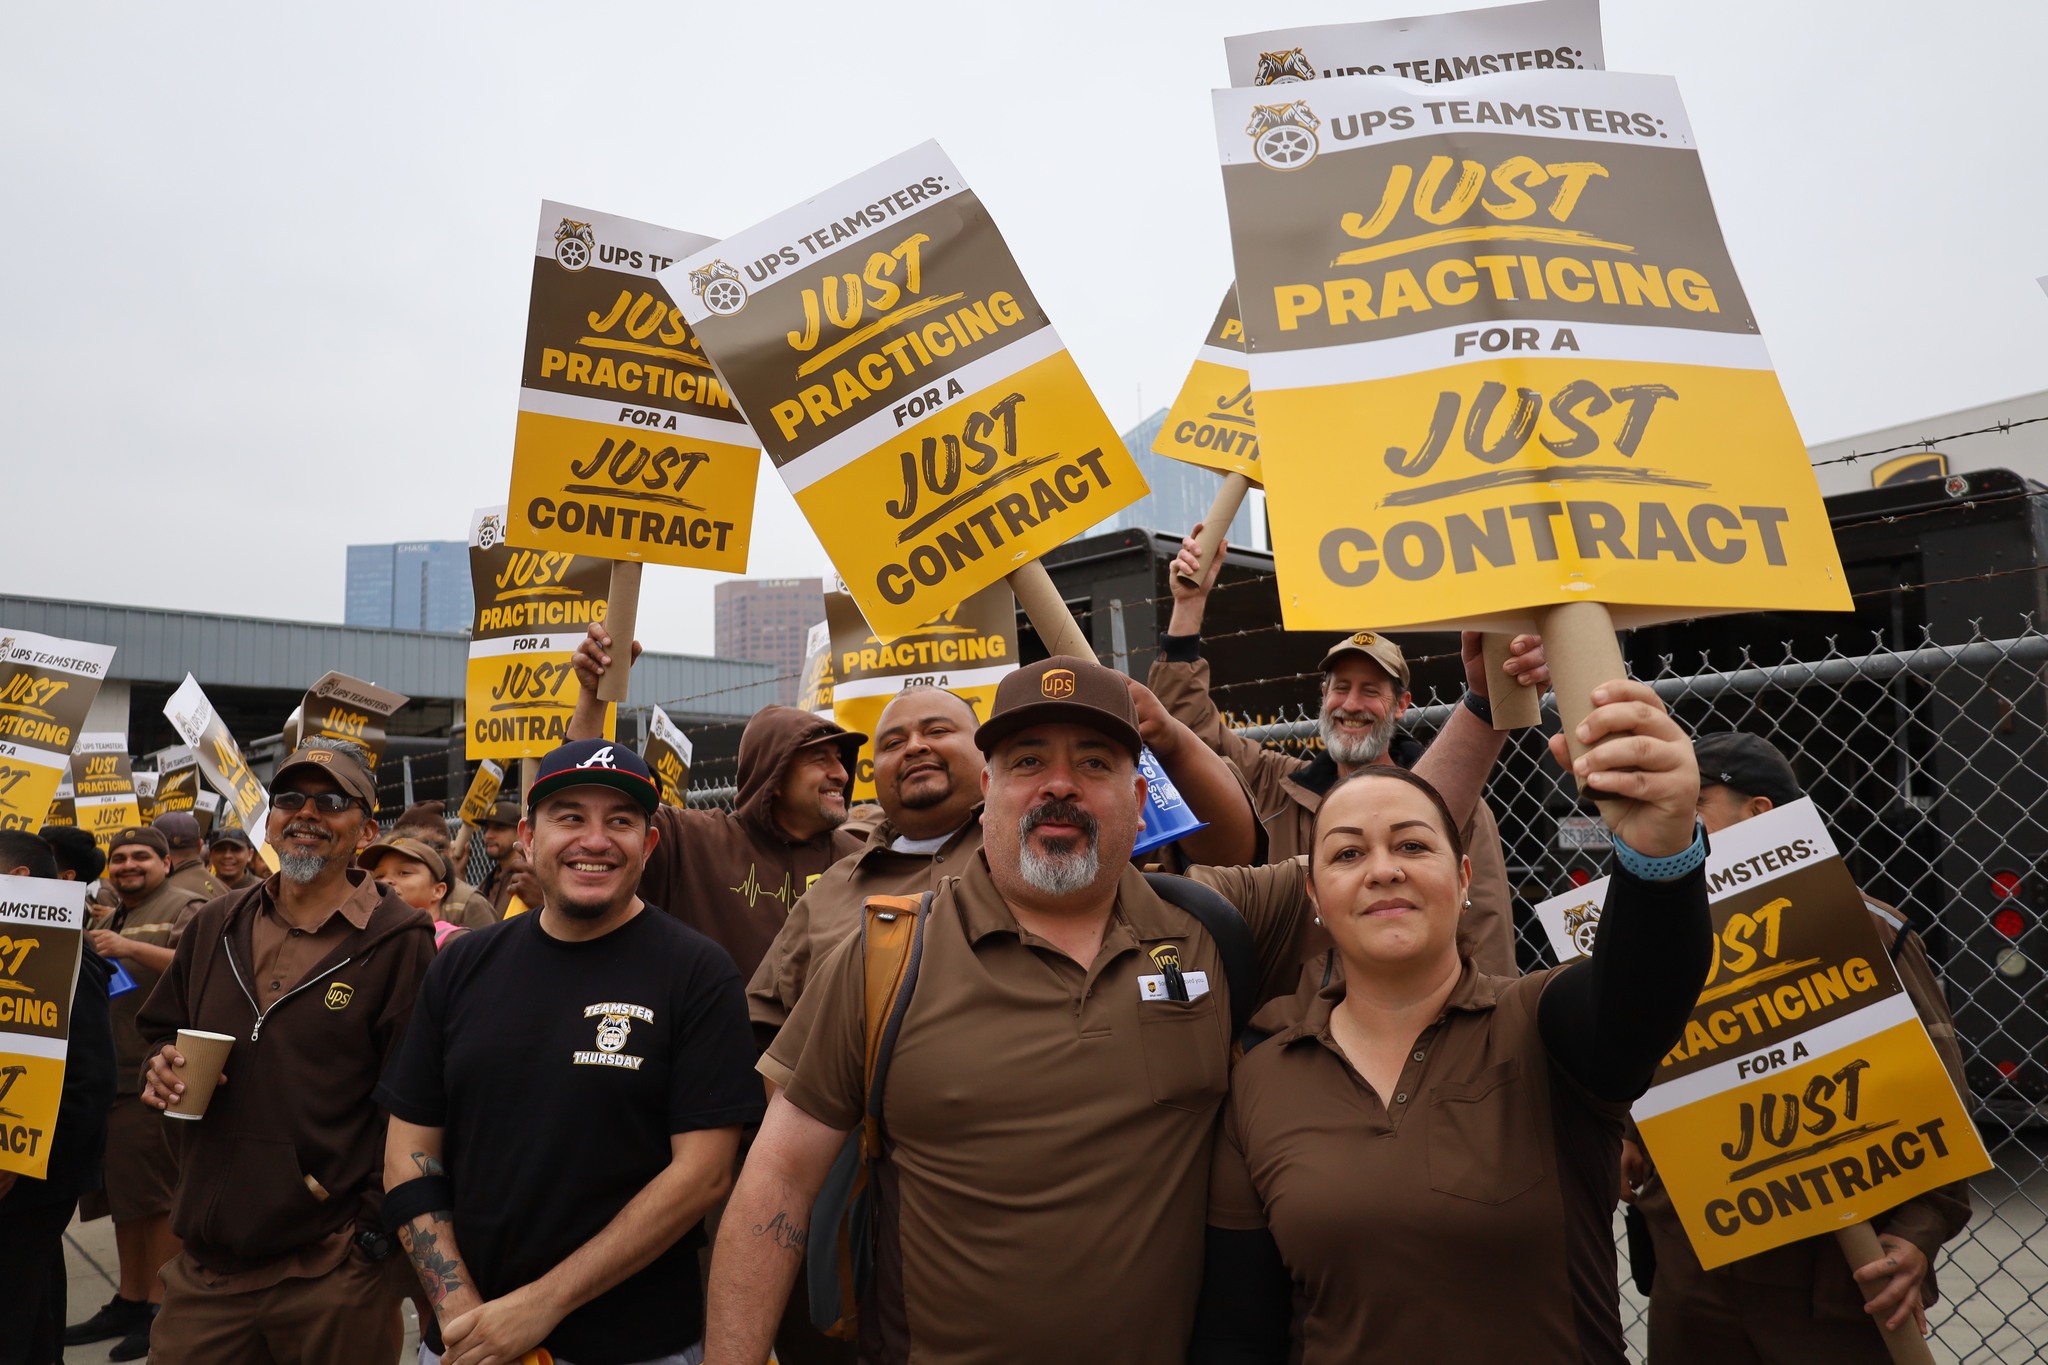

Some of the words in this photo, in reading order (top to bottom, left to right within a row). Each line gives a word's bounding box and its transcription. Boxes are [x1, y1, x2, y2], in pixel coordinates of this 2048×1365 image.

[1331, 105, 1415, 142] UPS
[1423, 101, 1668, 139] TEAMSTERS:
[1340, 154, 1610, 240] JUST
[744, 245, 800, 284] UPS
[798, 175, 950, 256] TEAMSTERS:
[599, 244, 643, 269] UPS
[786, 232, 931, 352] JUST
[1273, 255, 1720, 331] PRACTICING
[1454, 327, 1540, 357] FOR
[1550, 327, 1581, 351] A
[540, 347, 737, 410] PRACTICIN
[769, 290, 1026, 442] PRACTICING
[618, 407, 660, 428] FOR
[663, 415, 677, 431] A
[892, 392, 943, 428] FOR
[946, 377, 965, 402] A
[1383, 379, 1679, 477] JUST
[570, 437, 710, 493] JUST
[885, 391, 1027, 520] JUST
[527, 496, 734, 552] CONTRACT
[875, 447, 1113, 607] CONTRACT
[398, 543, 430, 553] CHASE
[1317, 499, 1790, 588] CONTRACT
[495, 550, 576, 589] JUST
[479, 599, 609, 632] PRACTICING
[512, 638, 537, 651] FOR
[540, 637, 550, 649] A
[842, 635, 1006, 675] PRACTICING
[10, 647, 33, 661] UPS
[33, 651, 102, 675] TEAMSTERS:
[0, 673, 69, 706] JUST
[333, 687, 351, 699] UPS
[491, 661, 575, 700] JUST
[904, 676, 935, 688] FOR
[938, 675, 949, 686] A
[322, 706, 368, 737] JUST
[8, 746, 17, 756] A
[86, 756, 119, 775] JUST
[308, 753, 330, 764] ups
[657, 751, 683, 783] JUST
[77, 780, 132, 794] PRACTICING
[1148, 784, 1165, 809] UPS
[94, 807, 127, 826] JUST
[327, 988, 350, 1006] ups
[584, 1002, 654, 1023] TEAMSTER
[573, 1052, 643, 1069] THURSDAY
[1737, 1048, 1787, 1080] FOR
[1792, 1040, 1809, 1061] A
[1720, 1058, 1871, 1162] JUST
[1703, 1117, 1950, 1237] CONTRACT
